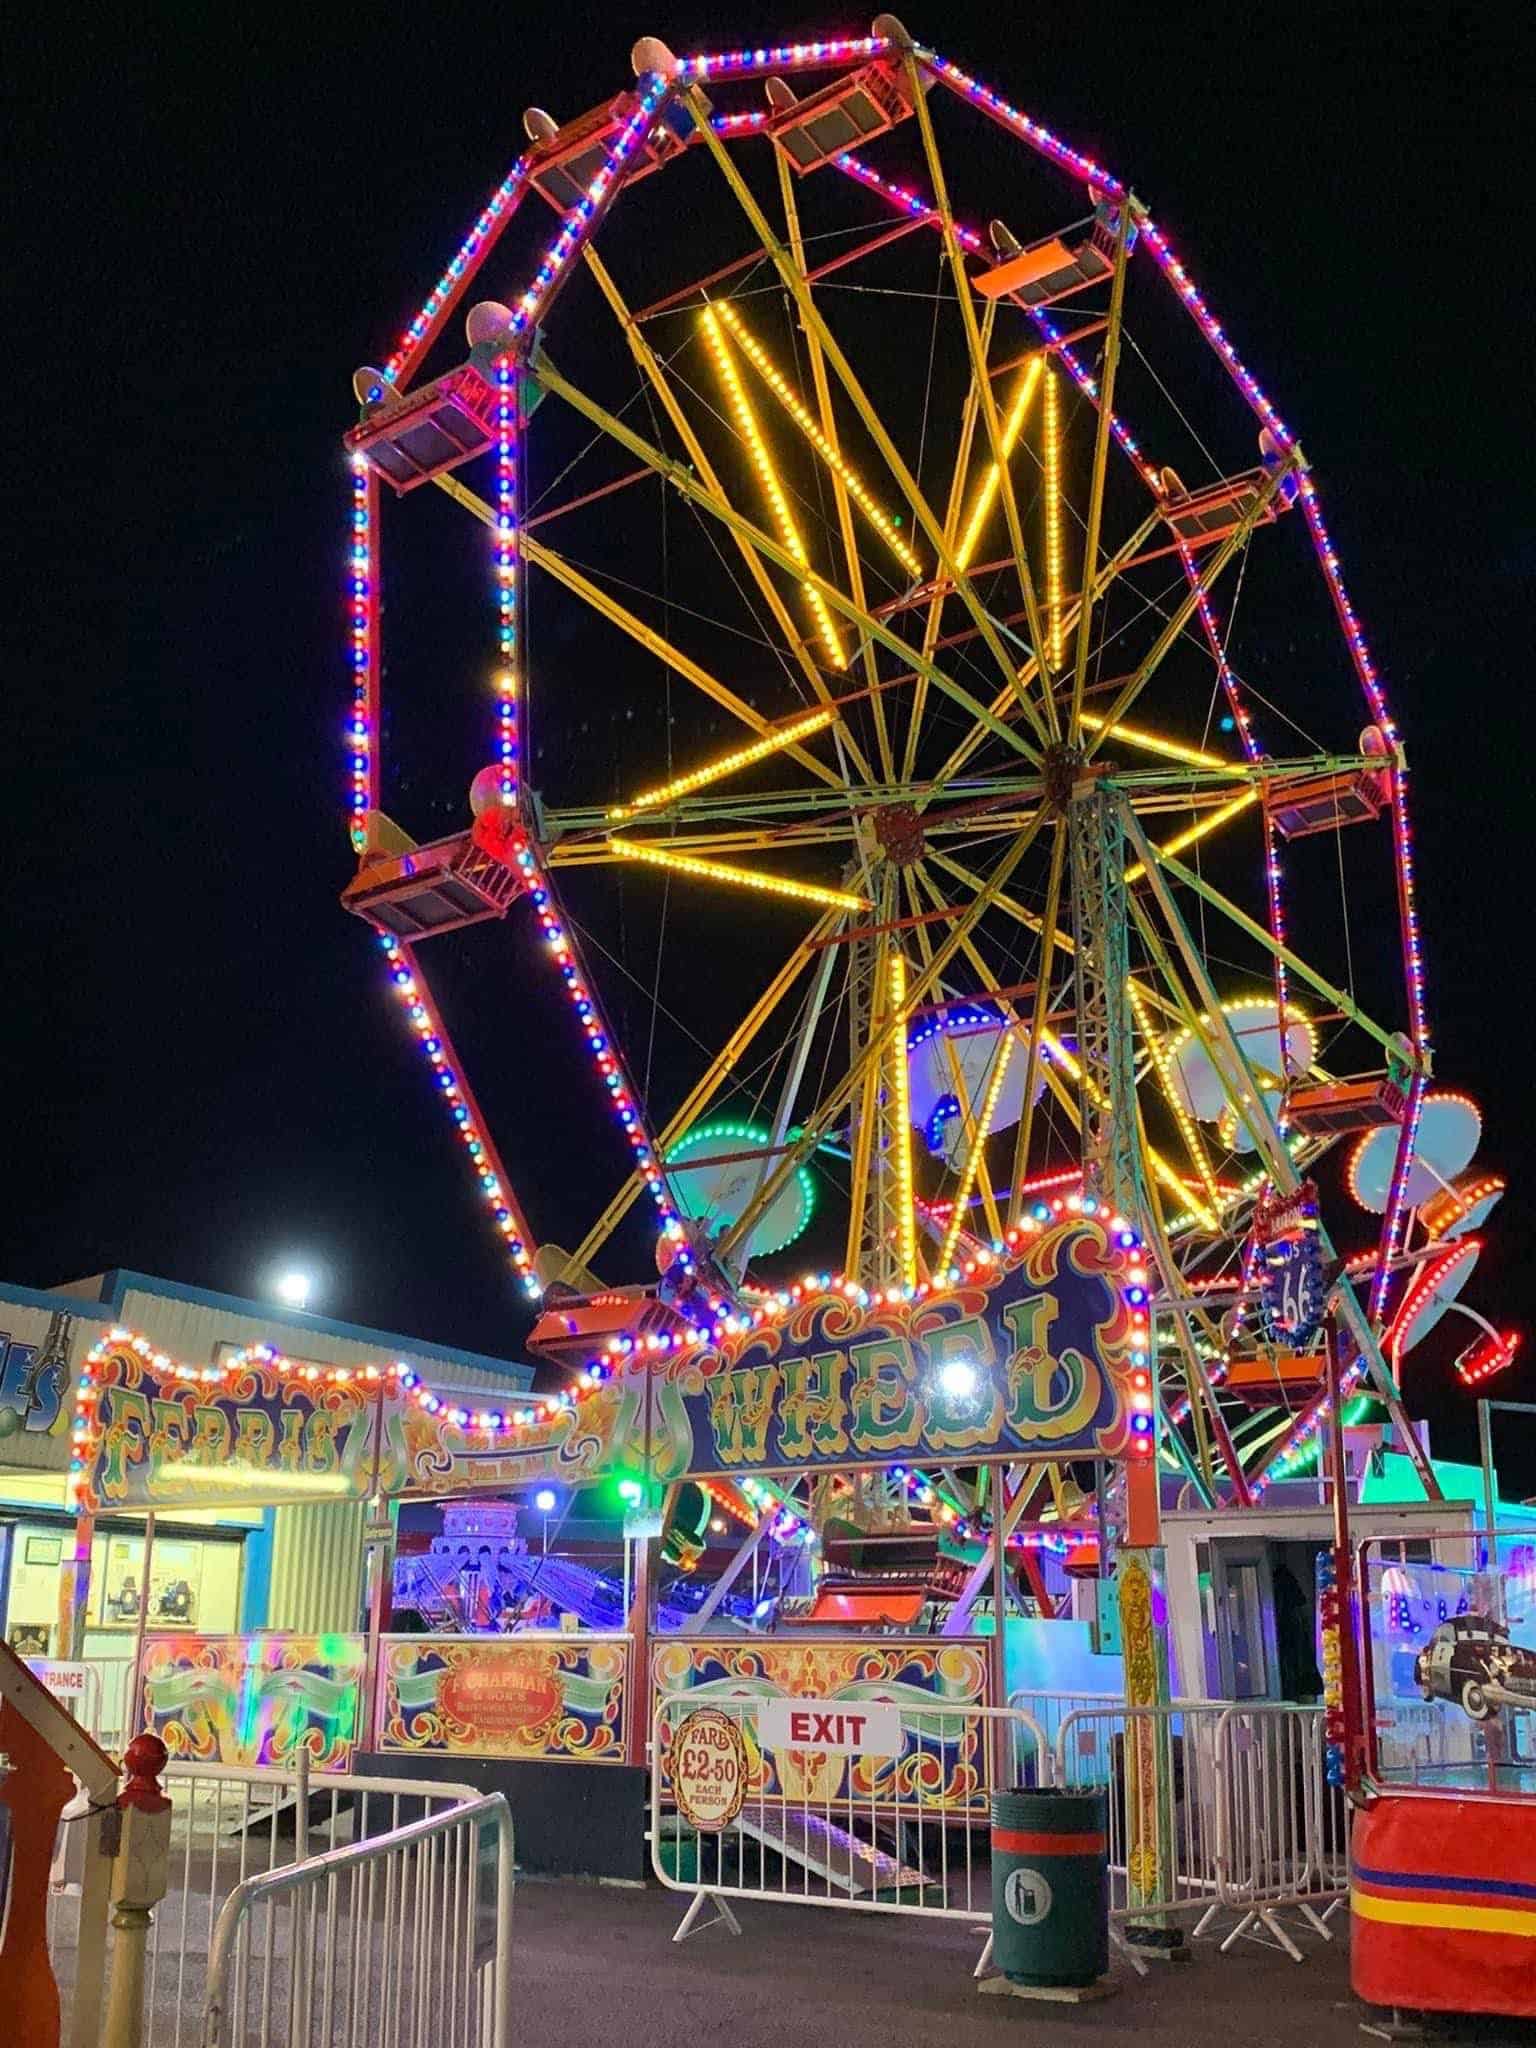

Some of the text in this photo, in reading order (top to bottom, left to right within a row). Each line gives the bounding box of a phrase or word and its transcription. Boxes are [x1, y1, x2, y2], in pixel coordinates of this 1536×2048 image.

[1282, 1264, 1310, 1329] 66
[0, 1331, 60, 1432] ES
[706, 1292, 1101, 1464] WHEEL
[102, 1386, 338, 1500] FERRIS
[37, 1671, 84, 1689] TRANCE
[791, 1711, 867, 1746] EXIT
[689, 1794, 728, 1807] PERSON
[695, 1784, 721, 1795] EACH
